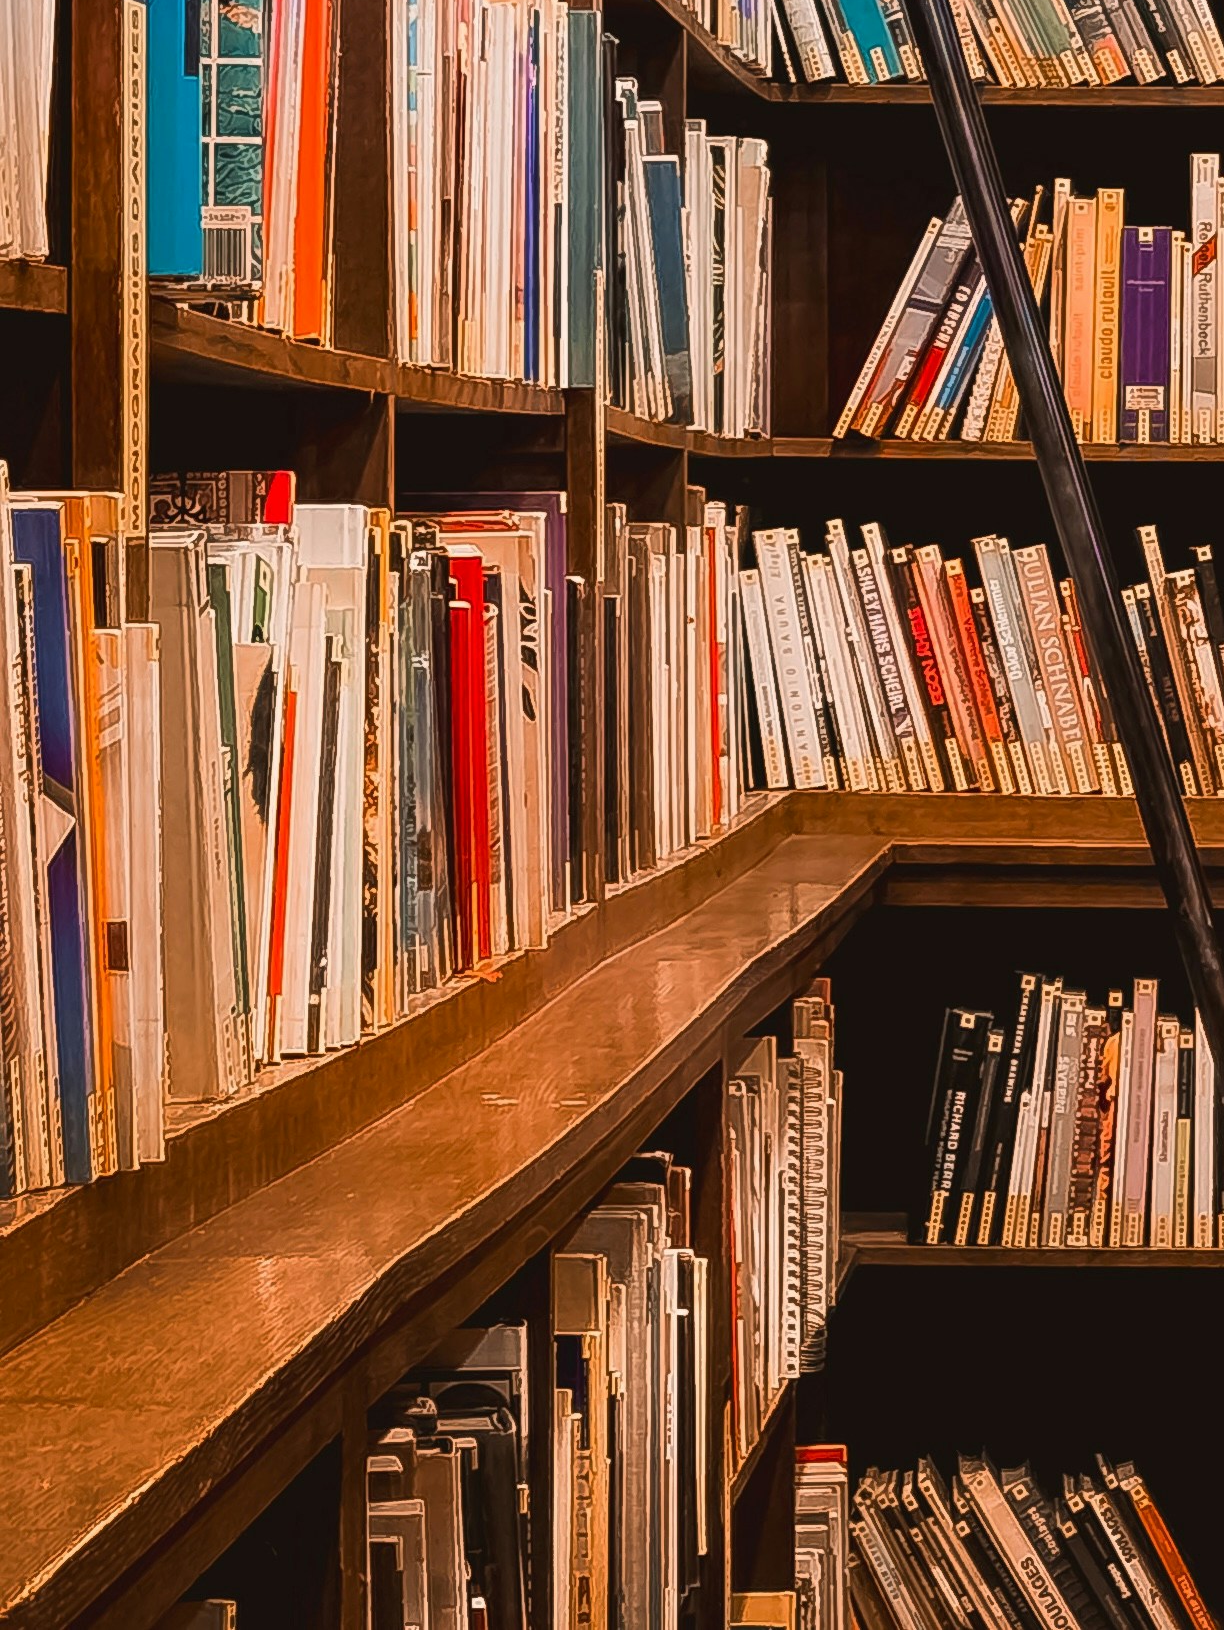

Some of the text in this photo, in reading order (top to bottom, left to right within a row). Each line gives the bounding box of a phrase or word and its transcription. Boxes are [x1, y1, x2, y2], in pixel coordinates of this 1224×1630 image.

[129, 7, 141, 531] MONOGRAPHIES D'ARTISTES
[954, 284, 972, 302] ED
[1197, 272, 1213, 357] Ruthenbeck
[947, 1092, 967, 1150] RICHARD
